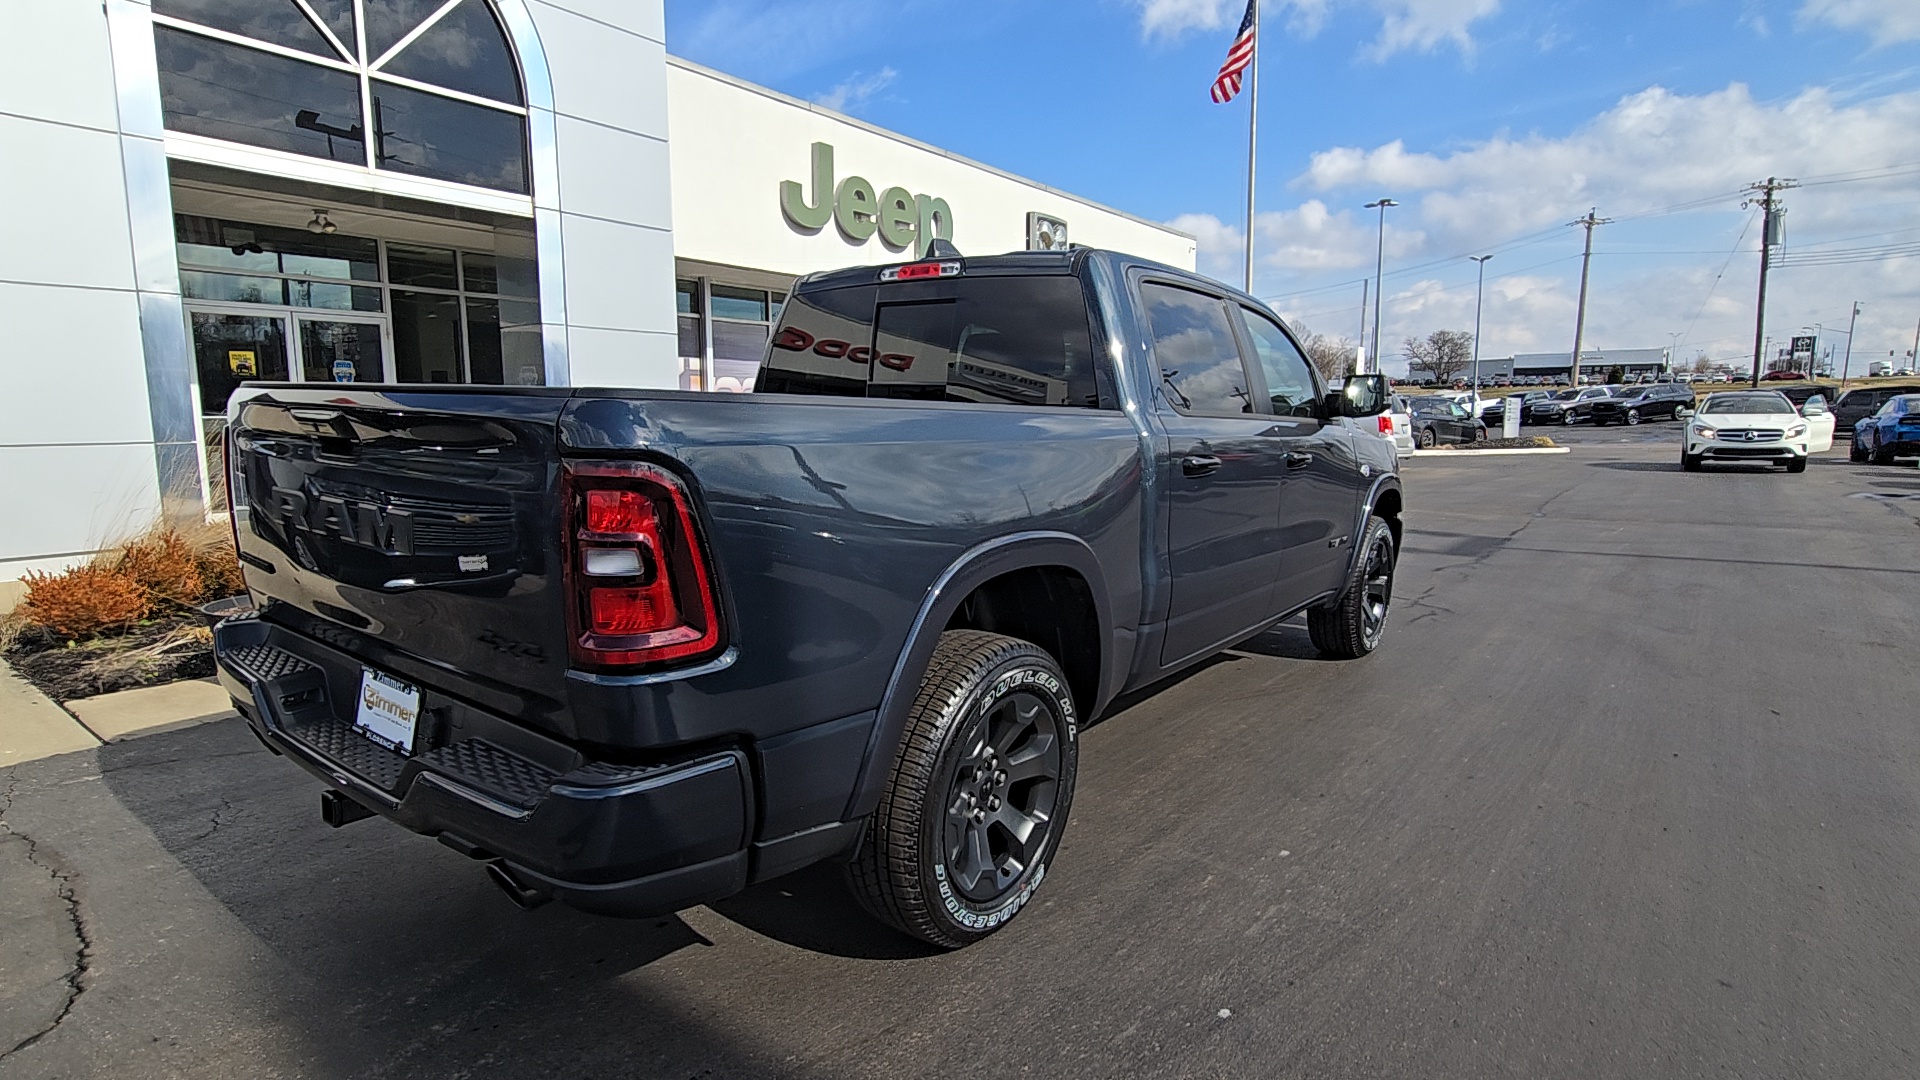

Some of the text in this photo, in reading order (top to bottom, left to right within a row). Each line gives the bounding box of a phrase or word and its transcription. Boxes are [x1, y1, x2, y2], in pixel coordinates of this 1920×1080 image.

[779, 141, 954, 259] Jeep
[272, 486, 414, 556] RAM
[363, 684, 416, 724] Zimmer
[980, 670, 1060, 718] DUELER
[934, 863, 1045, 929] BRIDGESTONE
